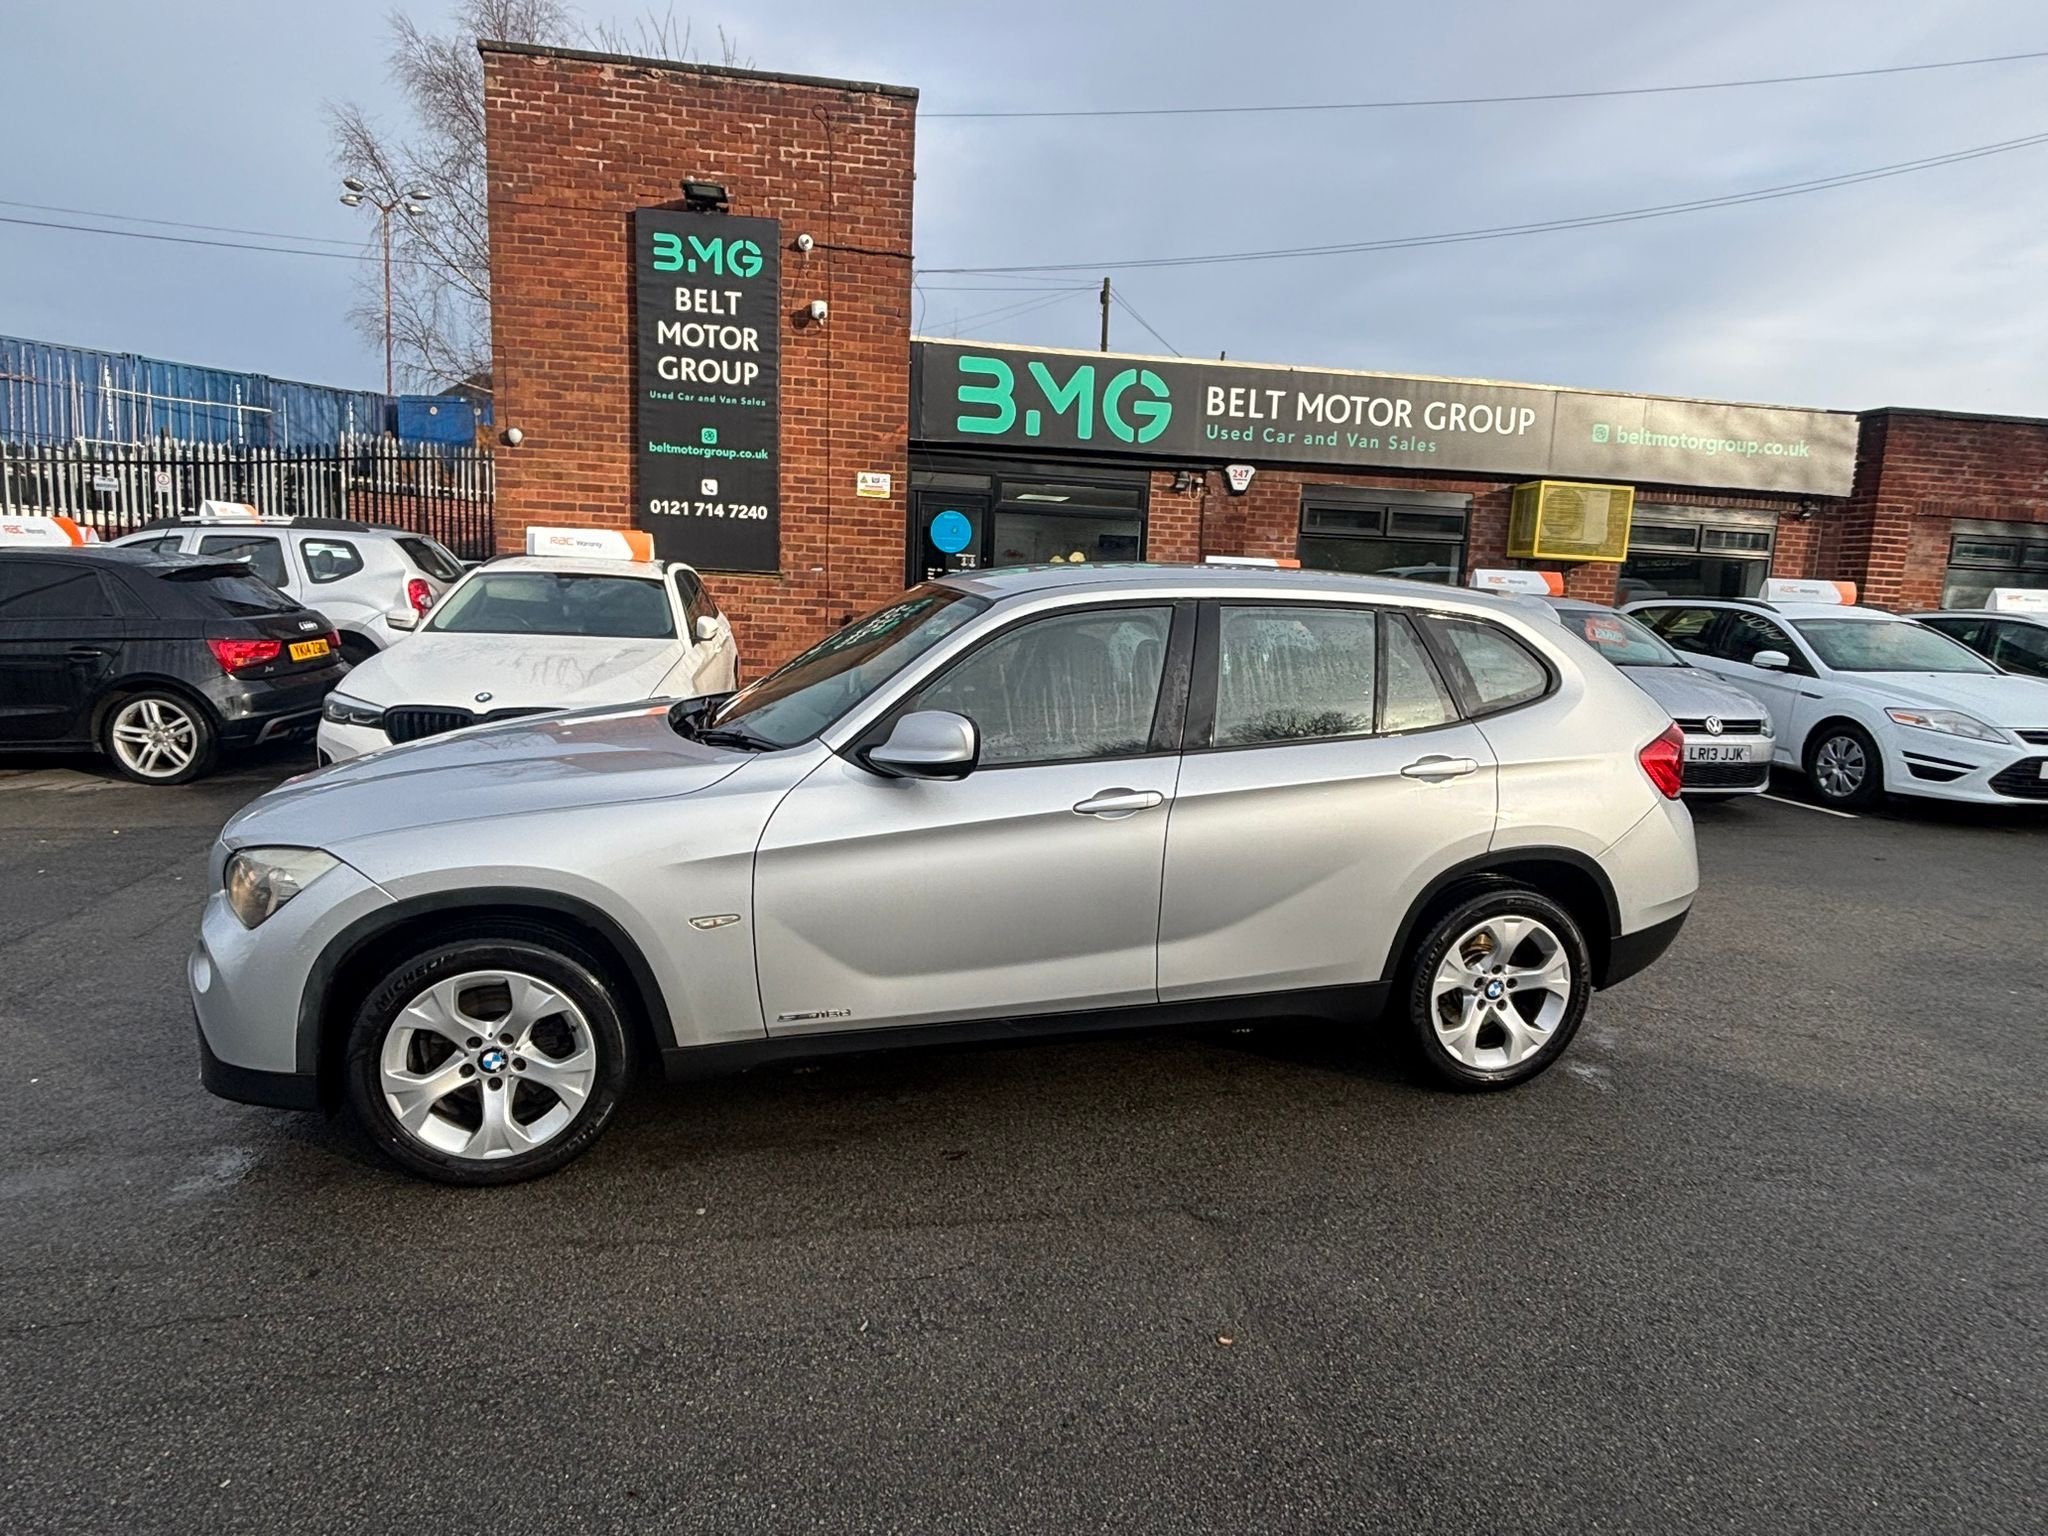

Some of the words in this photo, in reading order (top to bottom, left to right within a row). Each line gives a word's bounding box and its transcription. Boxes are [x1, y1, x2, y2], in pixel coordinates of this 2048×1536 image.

[653, 232, 763, 278] BMG
[675, 286, 743, 316] BELT
[657, 320, 760, 352] MOTOR
[657, 355, 760, 386] GROUP
[649, 390, 674, 400] Used
[677, 392, 695, 402] Car
[698, 395, 716, 404] and
[719, 396, 738, 405] Van
[741, 397, 766, 407] Sales
[956, 355, 1172, 444] BMG
[1206, 385, 1286, 420] BELT
[1297, 392, 1413, 428] MOTOR
[1423, 401, 1536, 436] GROUP
[649, 441, 769, 460] beltmotorgroup.co.uk
[1206, 425, 1254, 442] Used
[1263, 428, 1296, 444] Car
[1304, 430, 1338, 447] and
[1347, 433, 1380, 449] Van
[1388, 435, 1437, 453] Sales
[1616, 425, 1810, 459] beltmotorgroup.co.uk
[650, 499, 690, 516] 0121
[694, 502, 725, 518] 714
[728, 504, 768, 520] 7240
[1689, 747, 1718, 761] LR13
[1721, 747, 1743, 761] JJK
